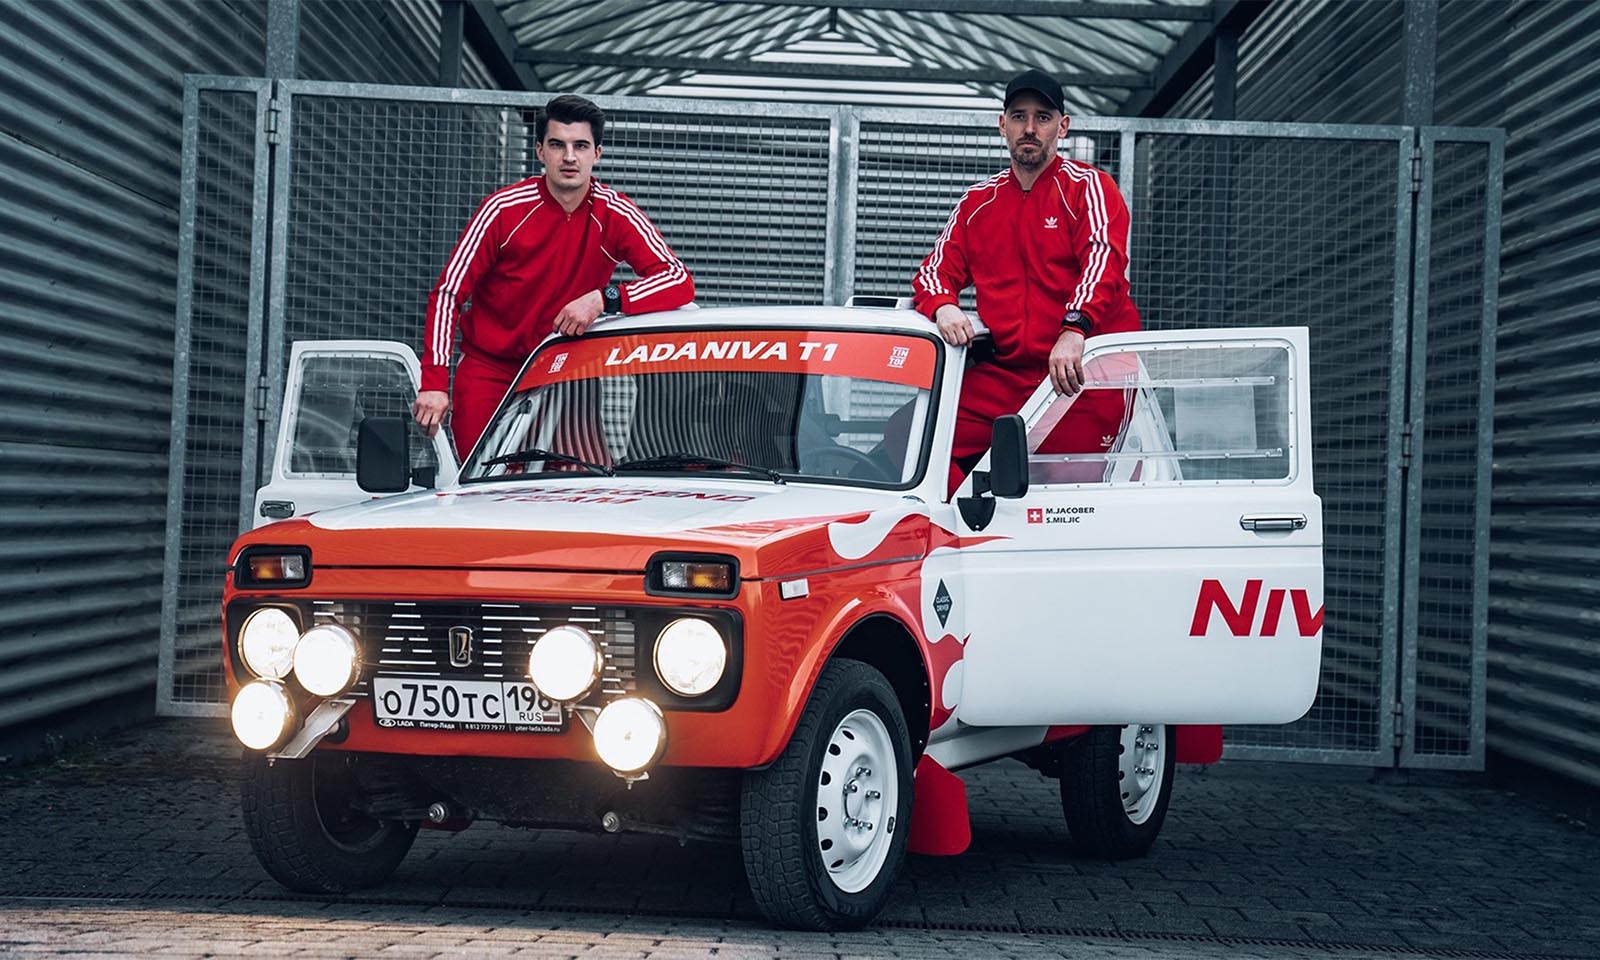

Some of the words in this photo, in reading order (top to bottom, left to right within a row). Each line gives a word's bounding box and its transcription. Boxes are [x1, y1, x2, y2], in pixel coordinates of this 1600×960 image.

[605, 342, 697, 366] LADA
[700, 341, 788, 360] NIVA
[798, 342, 839, 362] T1
[1045, 506, 1095, 514] M.JACOBER
[519, 711, 542, 722] RUS
